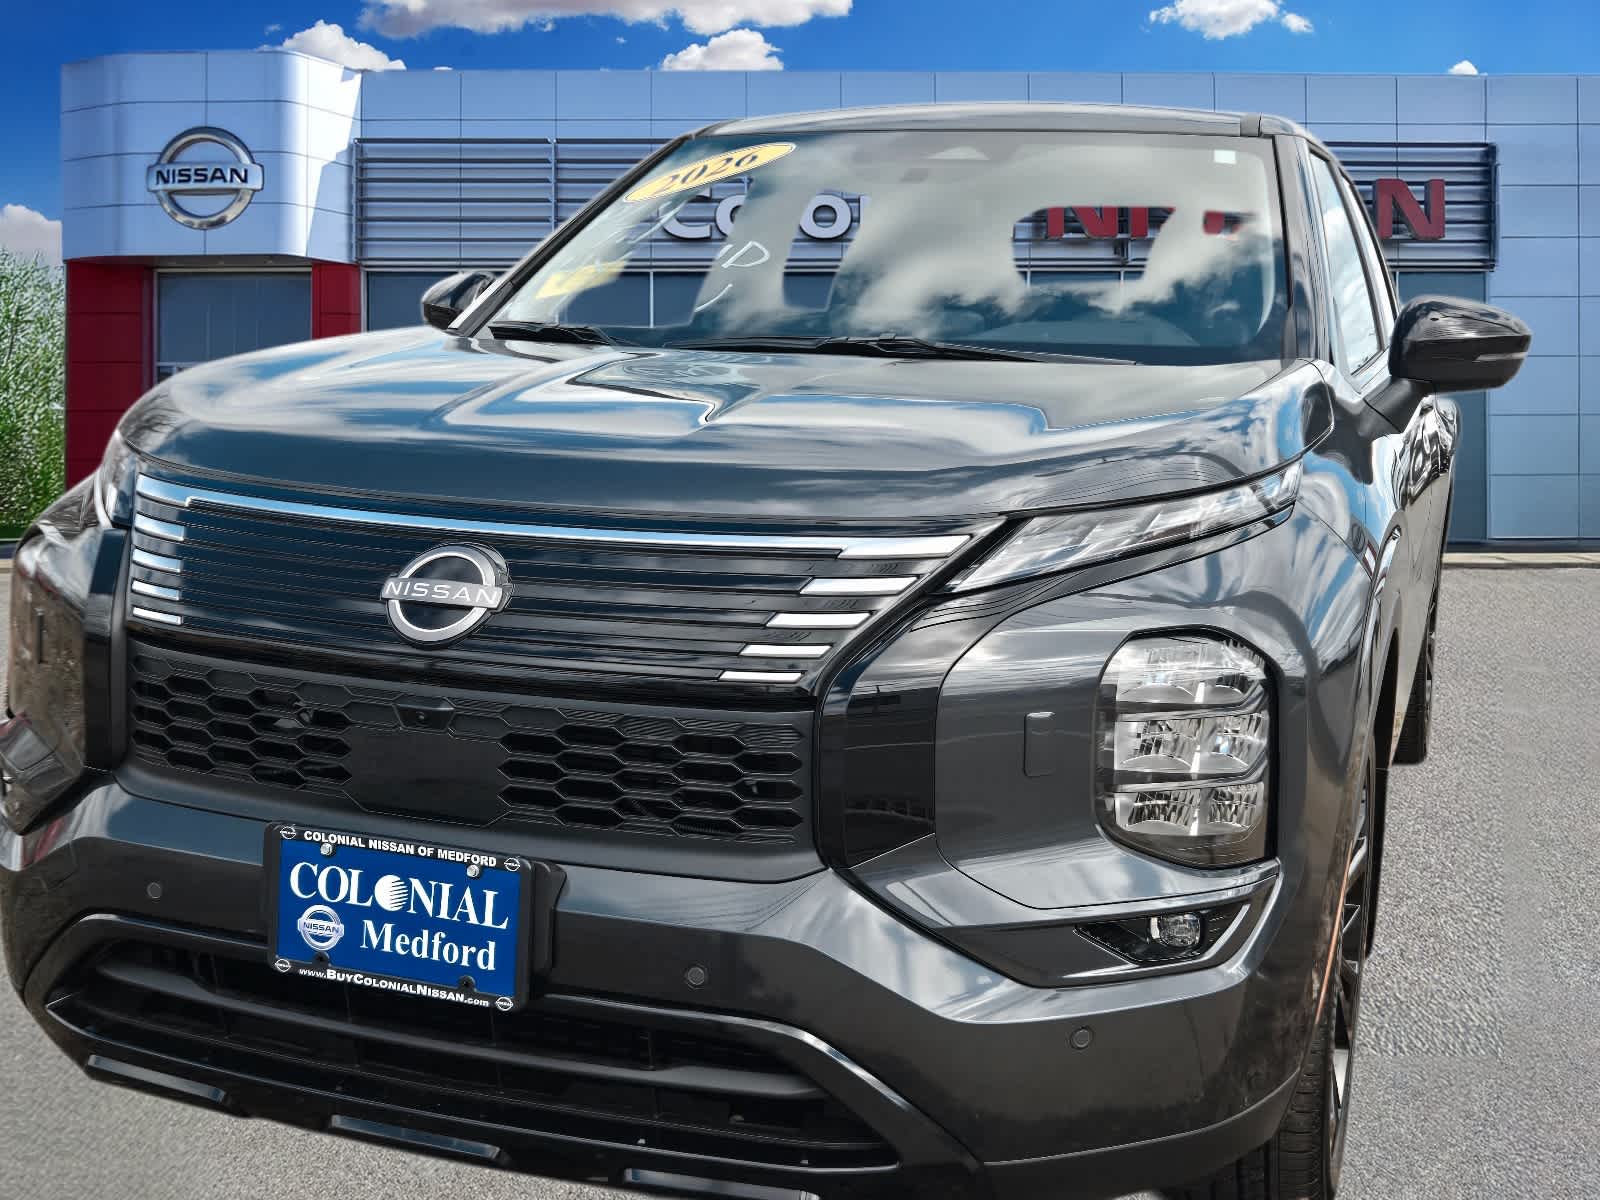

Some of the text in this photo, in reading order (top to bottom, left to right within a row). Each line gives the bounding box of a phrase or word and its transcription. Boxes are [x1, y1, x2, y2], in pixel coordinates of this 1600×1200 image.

[155, 167, 249, 186] NISSAN
[385, 580, 498, 604] NISSAN
[303, 830, 366, 848] COLONIAL
[368, 839, 415, 855] NISSAN
[417, 846, 434, 858] OF
[437, 848, 497, 868] MEDFORD
[289, 861, 509, 930] COLONIAL
[303, 921, 340, 934] NISSAN
[360, 919, 496, 971] Medford
